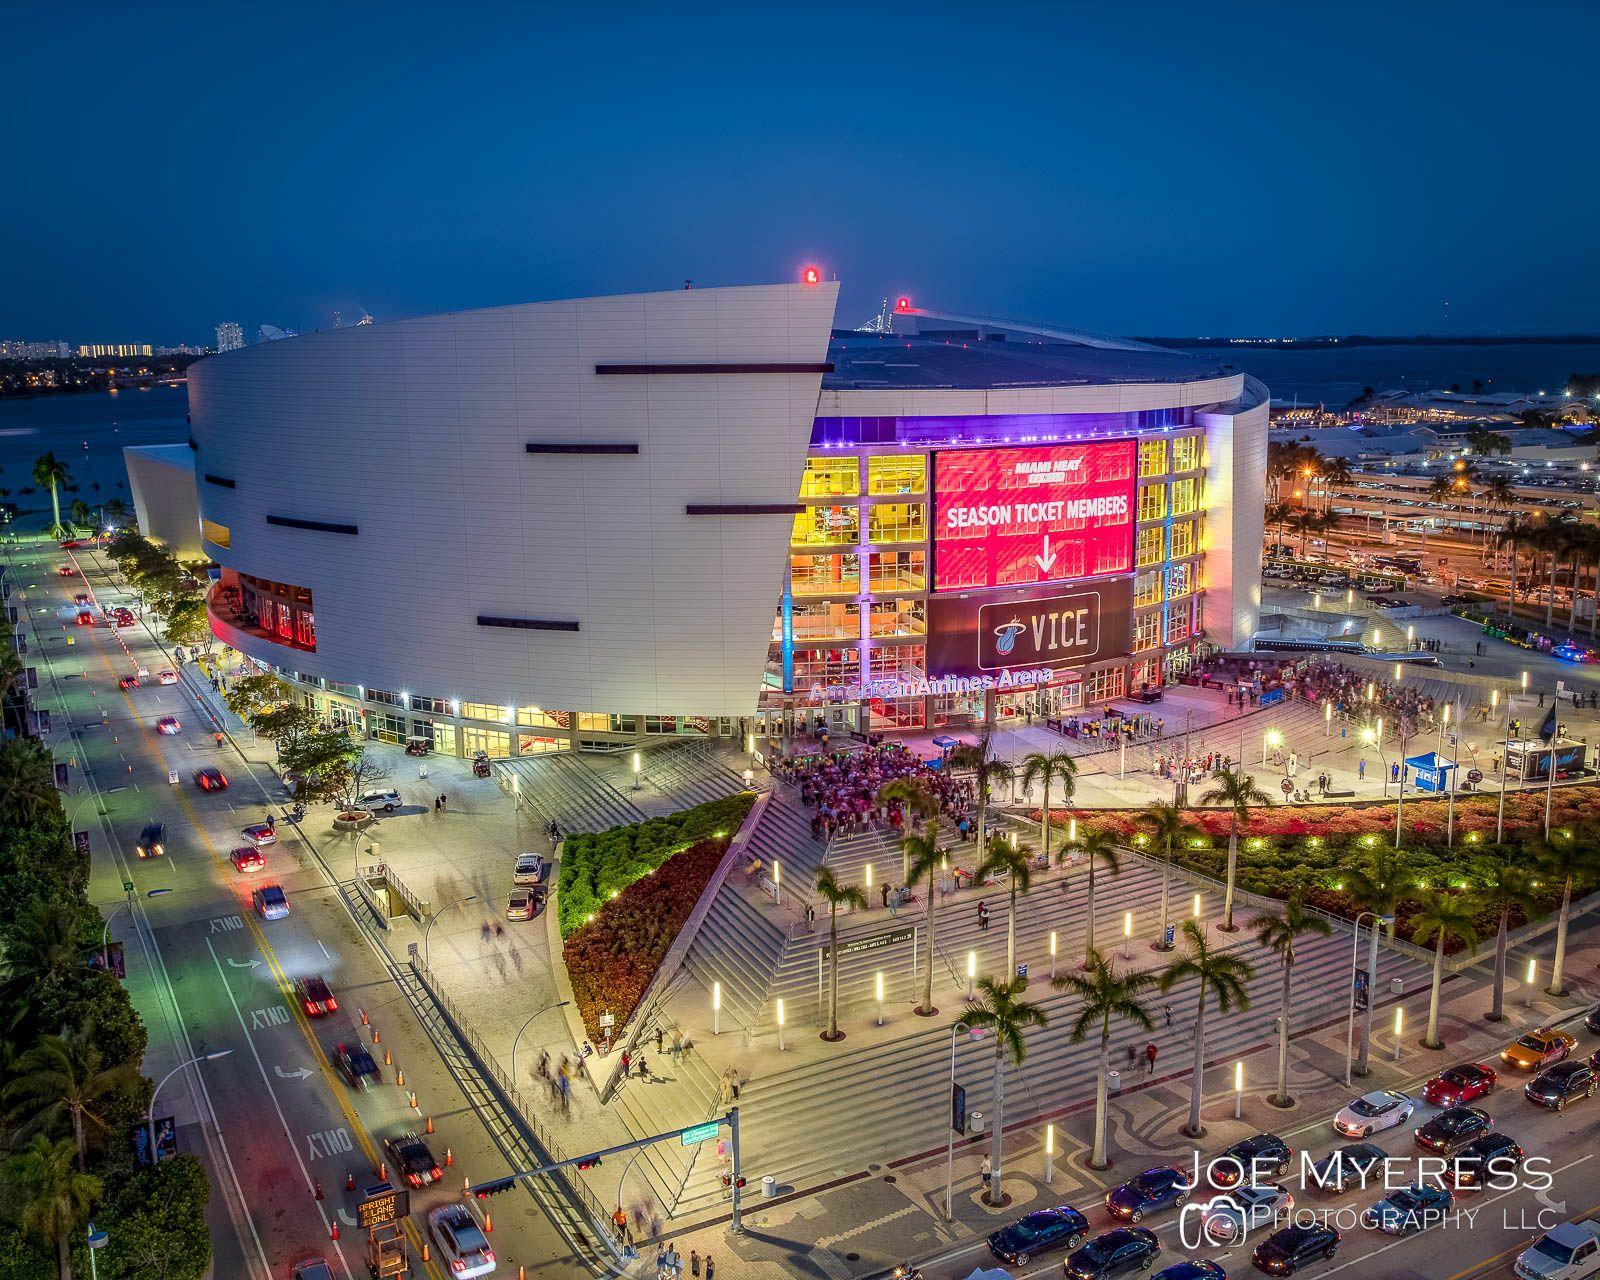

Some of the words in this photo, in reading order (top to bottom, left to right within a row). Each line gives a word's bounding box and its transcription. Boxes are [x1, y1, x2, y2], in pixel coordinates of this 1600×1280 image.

[1015, 461, 1051, 474] MIAMI
[1053, 455, 1084, 472] HEAT
[947, 504, 1011, 528] SEASON
[1015, 500, 1065, 523] TICKET
[1067, 495, 1128, 518] MEMBERS
[1031, 608, 1089, 652] VICE
[998, 666, 1054, 689] Arena
[208, 915, 244, 934] ONLY
[250, 1005, 290, 1030] ONLY
[306, 1127, 353, 1161] ONLY
[368, 1195, 396, 1210] RIGHT
[371, 1203, 395, 1217] LANE
[371, 1211, 395, 1225] ONLY
